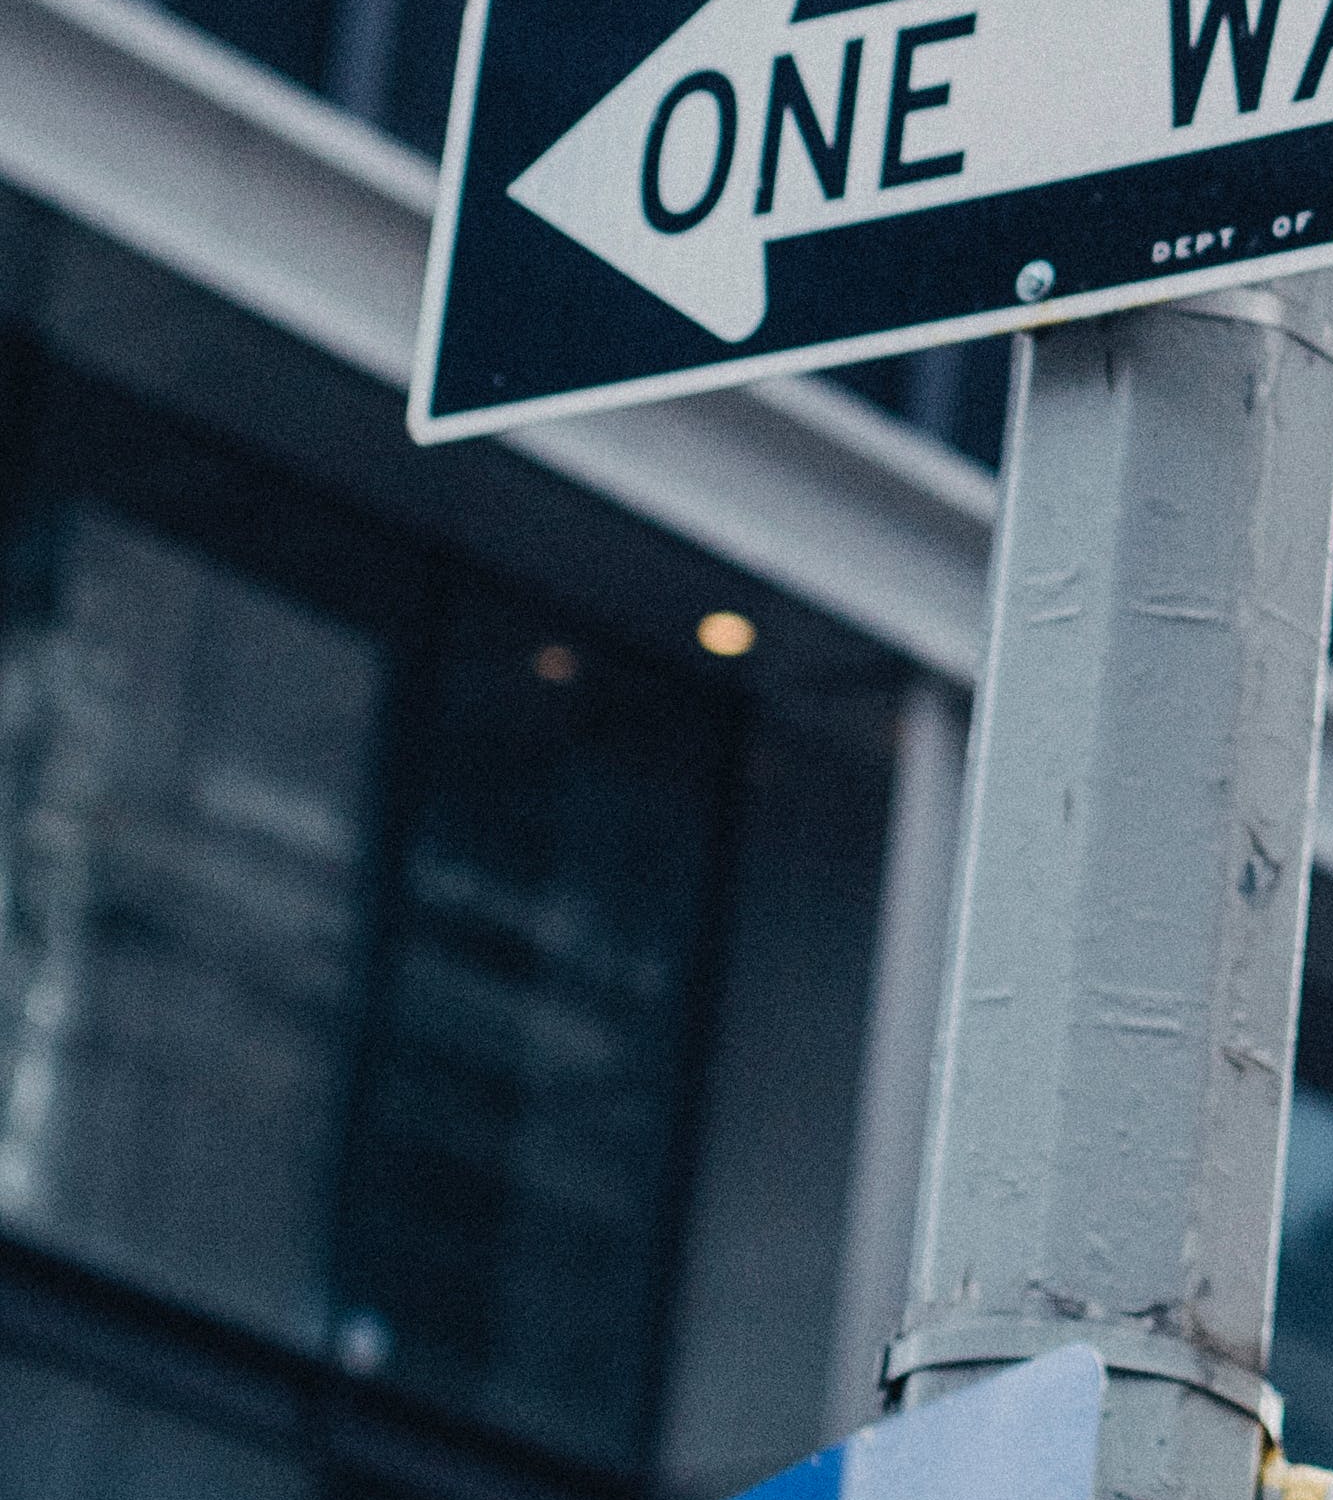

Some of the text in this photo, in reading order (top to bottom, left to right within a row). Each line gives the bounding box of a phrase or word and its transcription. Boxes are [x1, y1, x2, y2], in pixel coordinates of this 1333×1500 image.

[640, 12, 978, 235] ONE
[1152, 227, 1235, 263] DEPT
[1271, 210, 1314, 239] OF
